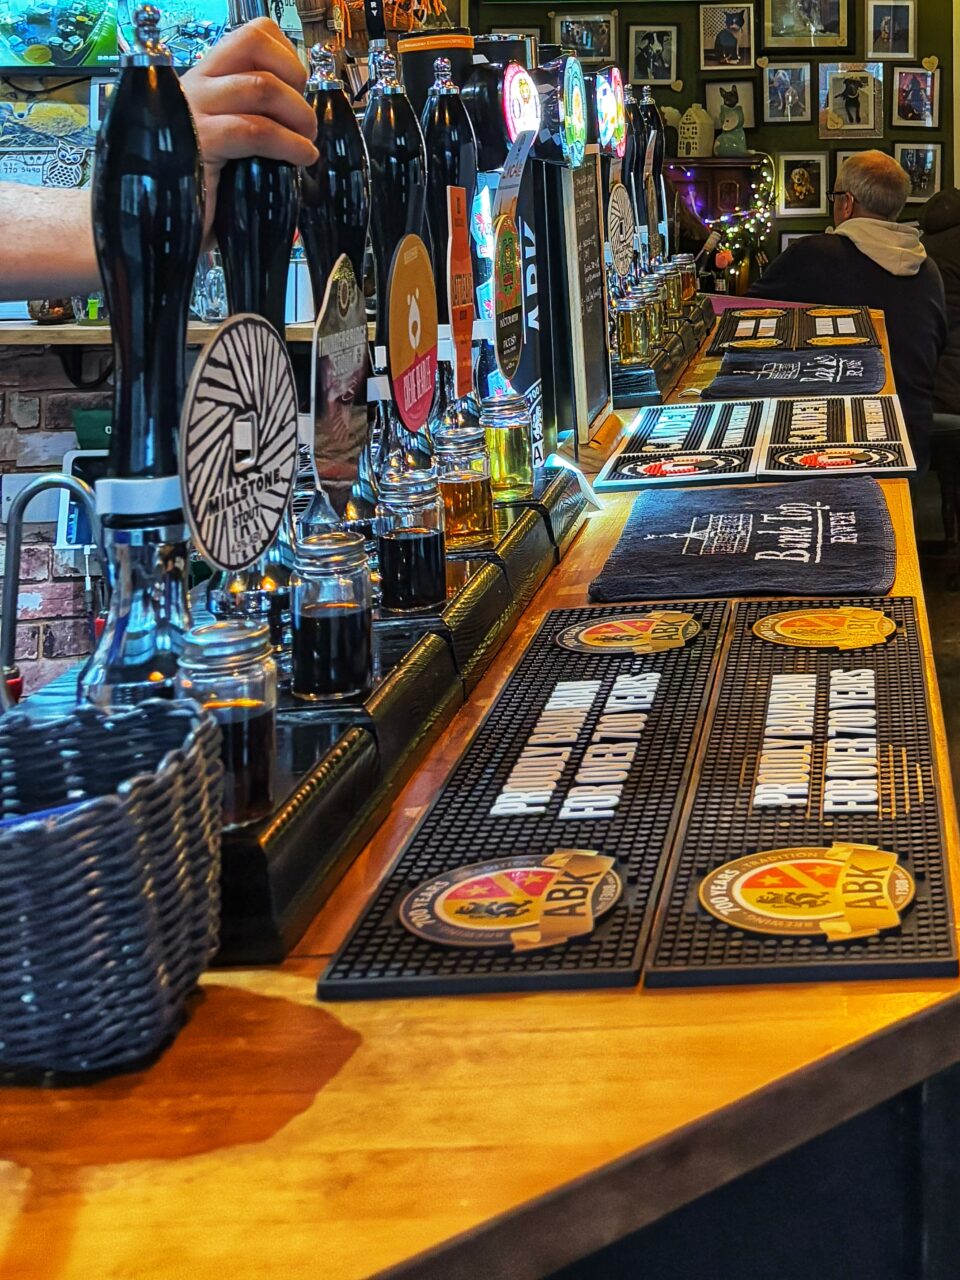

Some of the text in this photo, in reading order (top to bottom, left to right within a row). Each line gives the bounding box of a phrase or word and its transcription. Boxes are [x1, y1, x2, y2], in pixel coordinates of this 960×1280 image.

[641, 407, 699, 453] CAMDEN
[788, 400, 829, 444] CAMDEN
[207, 468, 281, 516] MILLSTONE
[233, 506, 260, 528] STOUT
[754, 502, 830, 563] Bank Top
[651, 619, 687, 641] ABK
[490, 680, 602, 816] PROUDLY BAVARIAN
[559, 672, 662, 820] FOR OVER 700 YEARS
[753, 673, 817, 806] PROUDLY BAVARIAN
[823, 669, 879, 813] FOR OVER 700 YEARS
[742, 851, 819, 870] TRADITION
[410, 880, 450, 928] 700 YEARS
[543, 870, 603, 917] ABK
[710, 868, 741, 916] 700 YEARS
[842, 864, 890, 910] ABK
